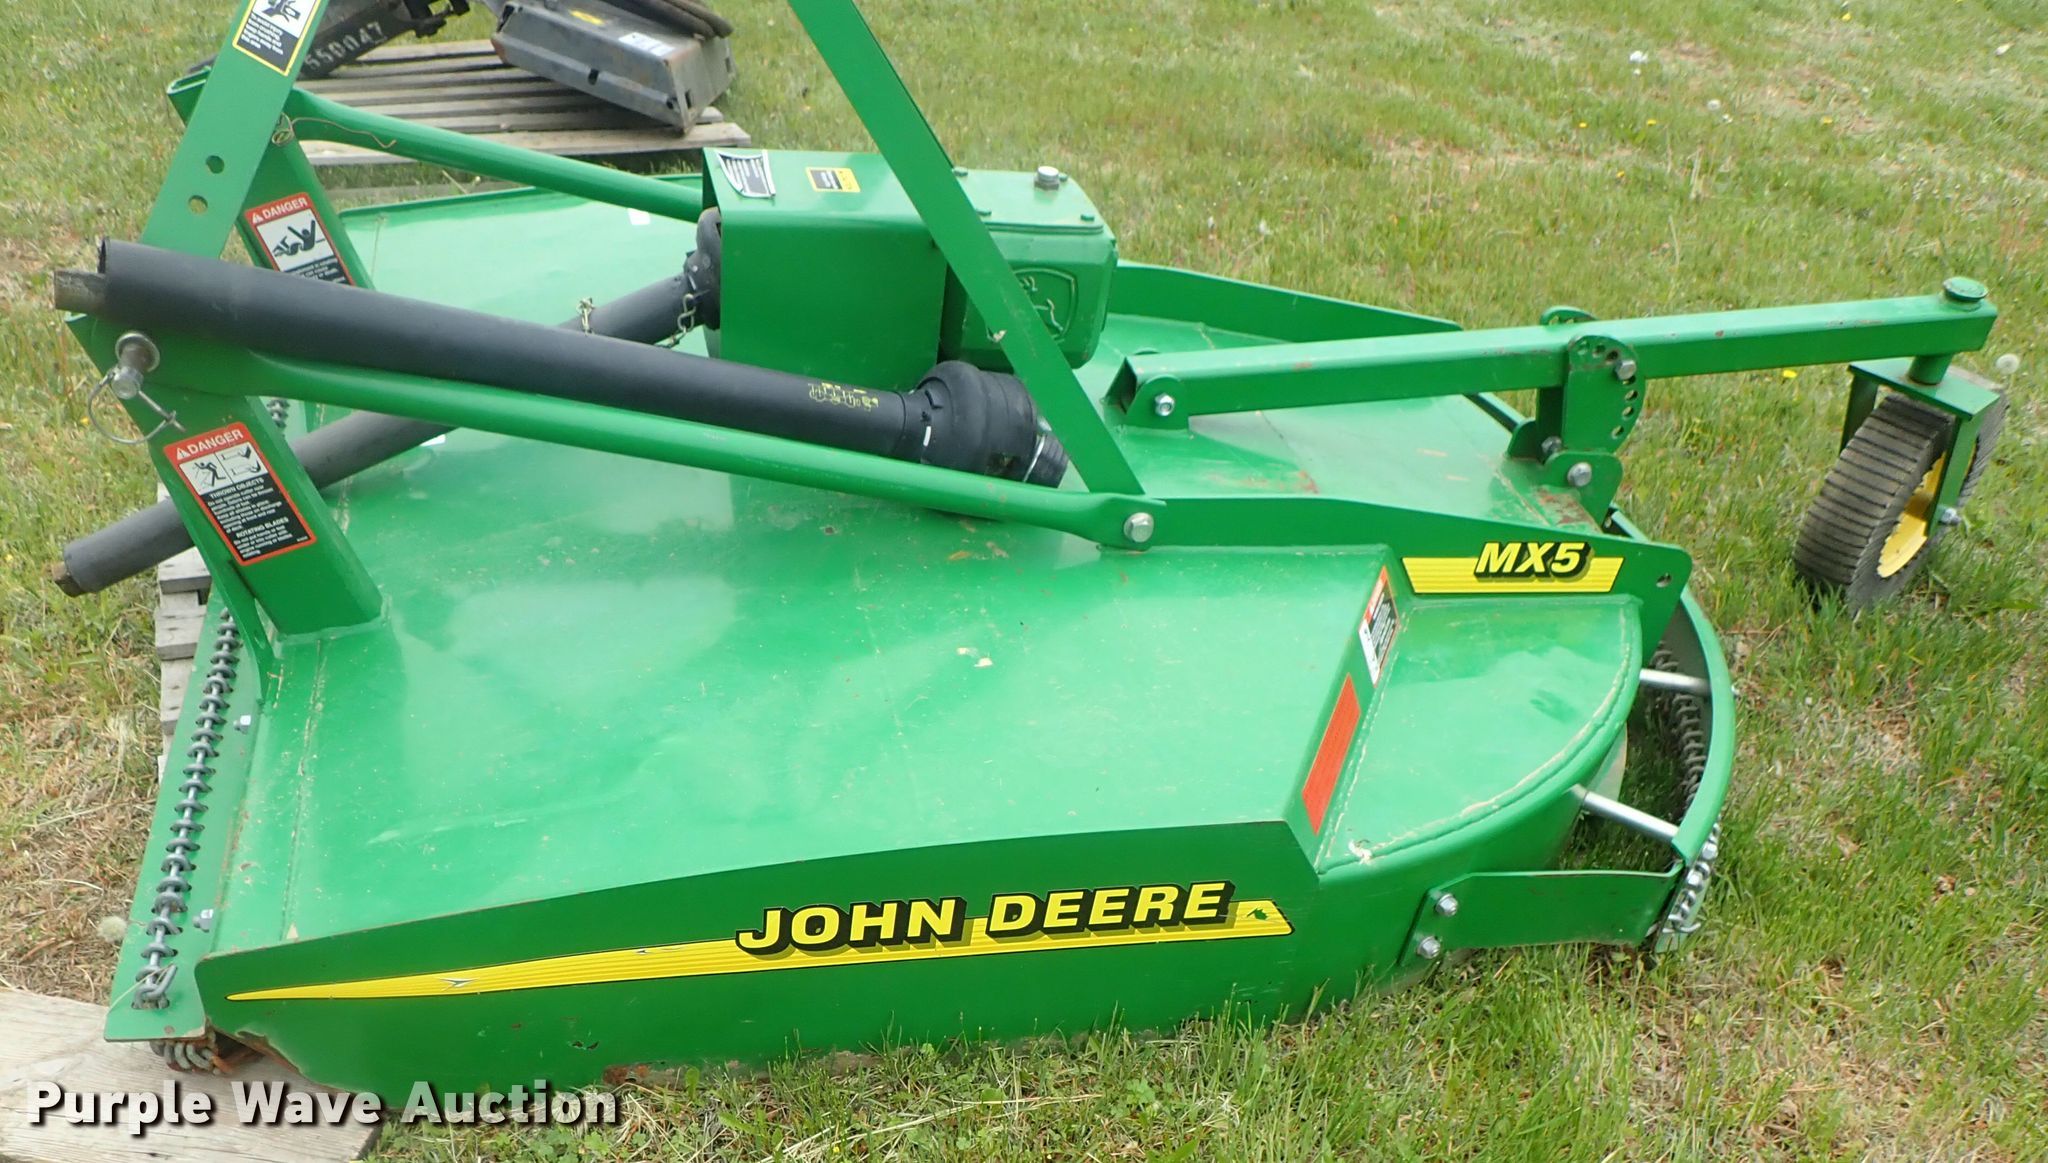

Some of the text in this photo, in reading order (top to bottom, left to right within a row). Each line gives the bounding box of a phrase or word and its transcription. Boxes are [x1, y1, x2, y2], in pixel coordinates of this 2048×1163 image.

[263, 197, 308, 219] DANGER
[187, 429, 243, 454] DANGER
[1474, 541, 1588, 577] MX5
[736, 880, 1232, 953] JOHN DEERE
